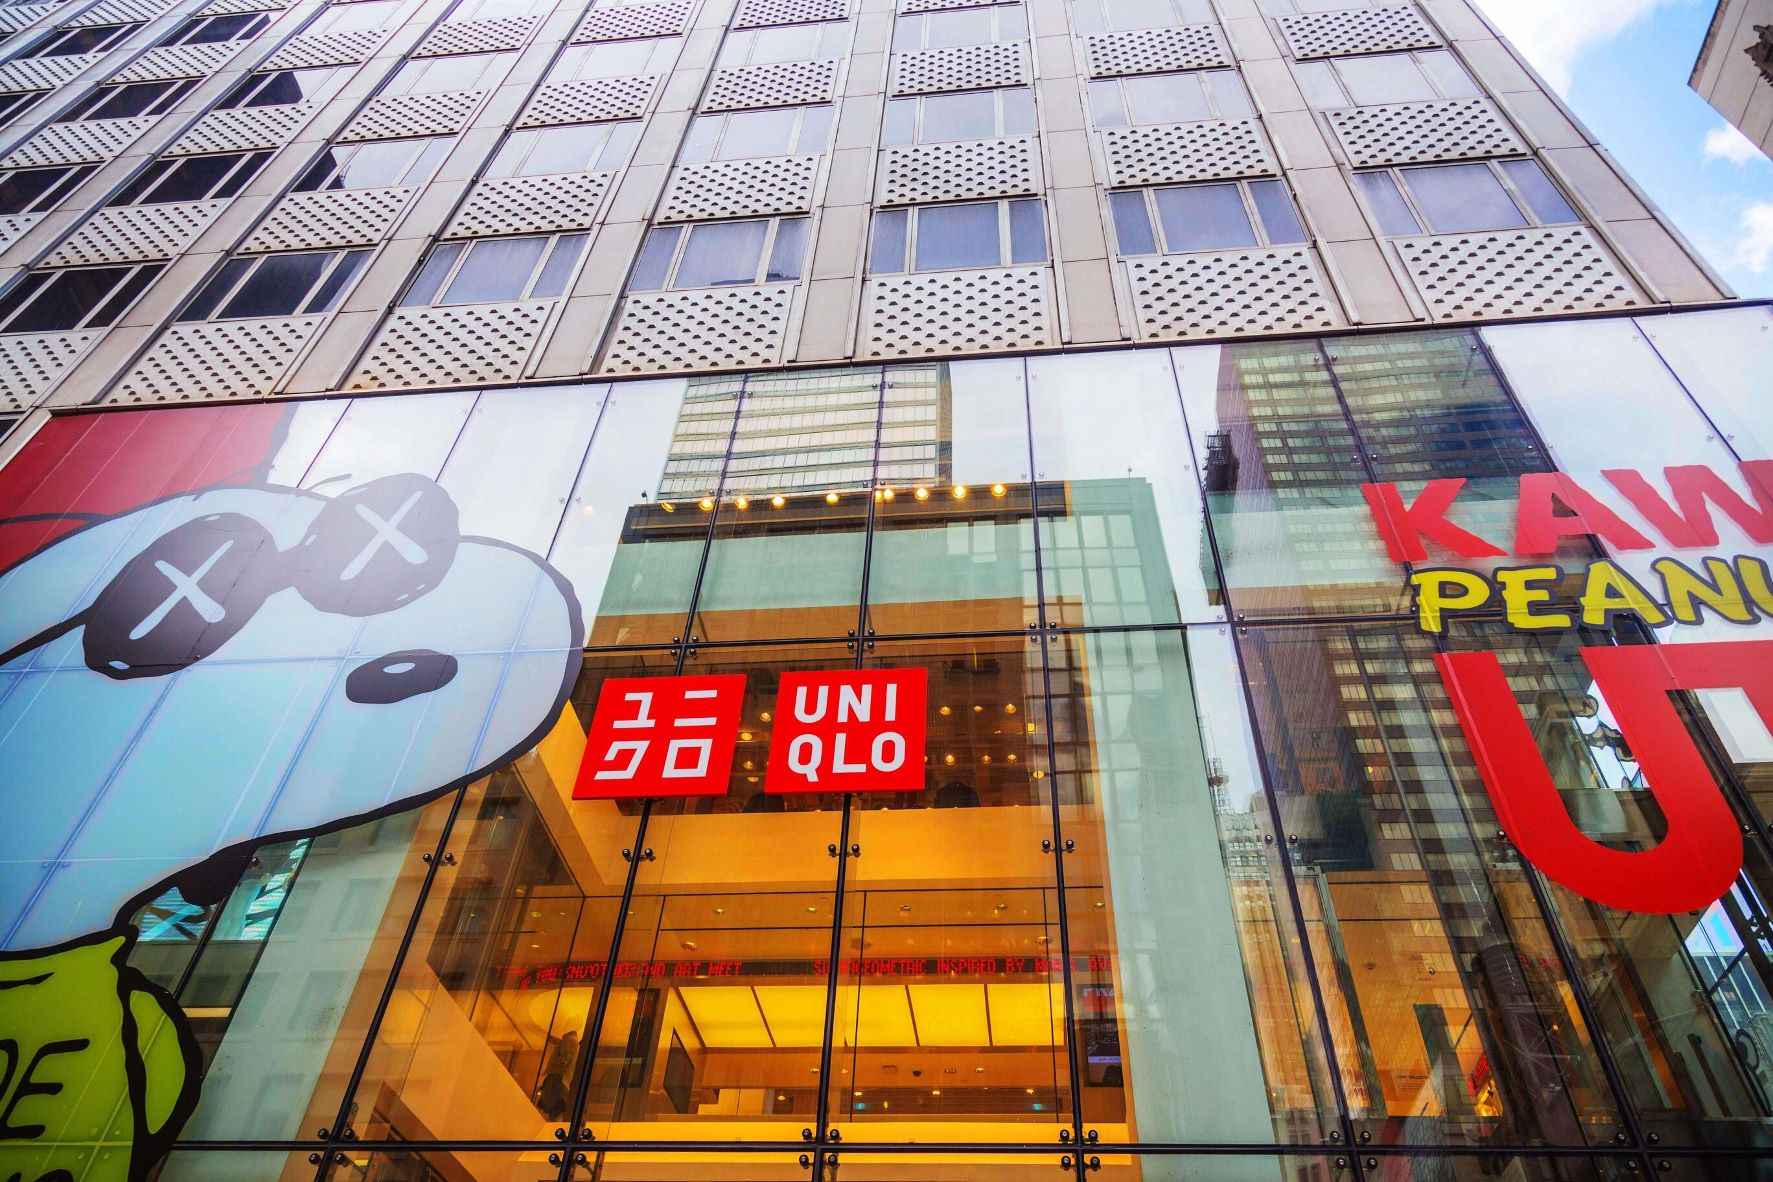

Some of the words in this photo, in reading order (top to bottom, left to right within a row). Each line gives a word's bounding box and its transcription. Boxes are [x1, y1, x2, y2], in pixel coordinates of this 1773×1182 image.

[1361, 459, 1773, 563] KAW
[793, 683, 898, 724] UNI
[787, 731, 906, 783] QLO
[937, 959, 996, 976] INSPIRED
